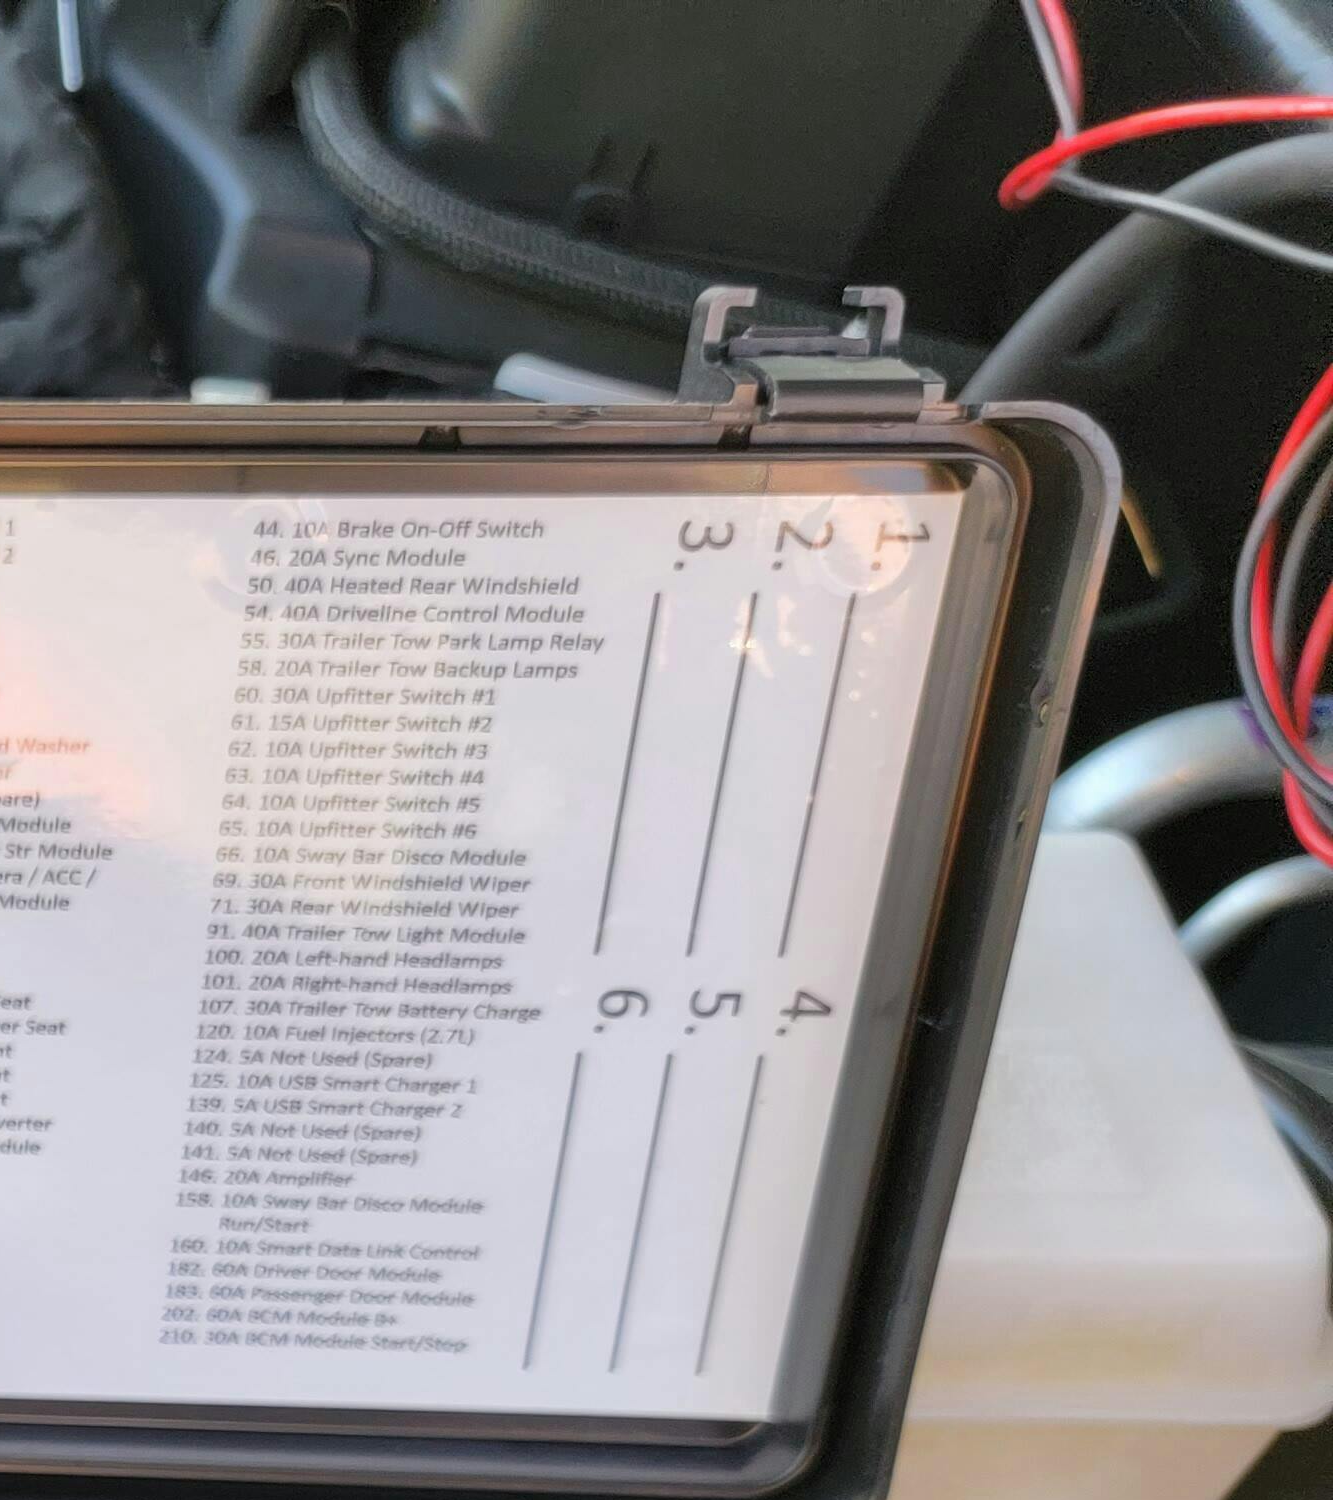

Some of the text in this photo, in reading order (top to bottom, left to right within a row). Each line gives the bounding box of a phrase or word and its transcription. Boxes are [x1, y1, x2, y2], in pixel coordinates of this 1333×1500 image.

[251, 520, 286, 537] 44.
[336, 520, 396, 538] Brake
[398, 520, 473, 538] On-Off
[474, 521, 546, 539] Switch
[248, 548, 467, 569] 46. 20A Sync Module
[245, 576, 580, 596] 50. 40A Heated Rear Windshield
[241, 604, 586, 624] 54. 40A Driveline Control Module
[238, 632, 606, 655] 55. 30A Trailer Tow Park Lamp Relay
[235, 659, 579, 682] 58. 20A Trailer Tow Backup Lamps
[232, 687, 497, 708] 60. 30A Upfitter Switch #1
[225, 741, 489, 762] 62. 10A Upfitter Switch #3
[4, 840, 33, 857] Str
[37, 841, 114, 857] Module
[213, 846, 528, 867] 66. 10A Sway Bar Disco Module
[210, 872, 533, 895] 69. 30A Front Windshield Wiper
[196, 999, 543, 1022] 107. 30A Trailer Tow Battery Charge
[193, 1024, 237, 1040] 120.
[240, 1024, 281, 1040] 10A
[284, 1025, 327, 1041] Fuel
[330, 1026, 417, 1045] Injectors
